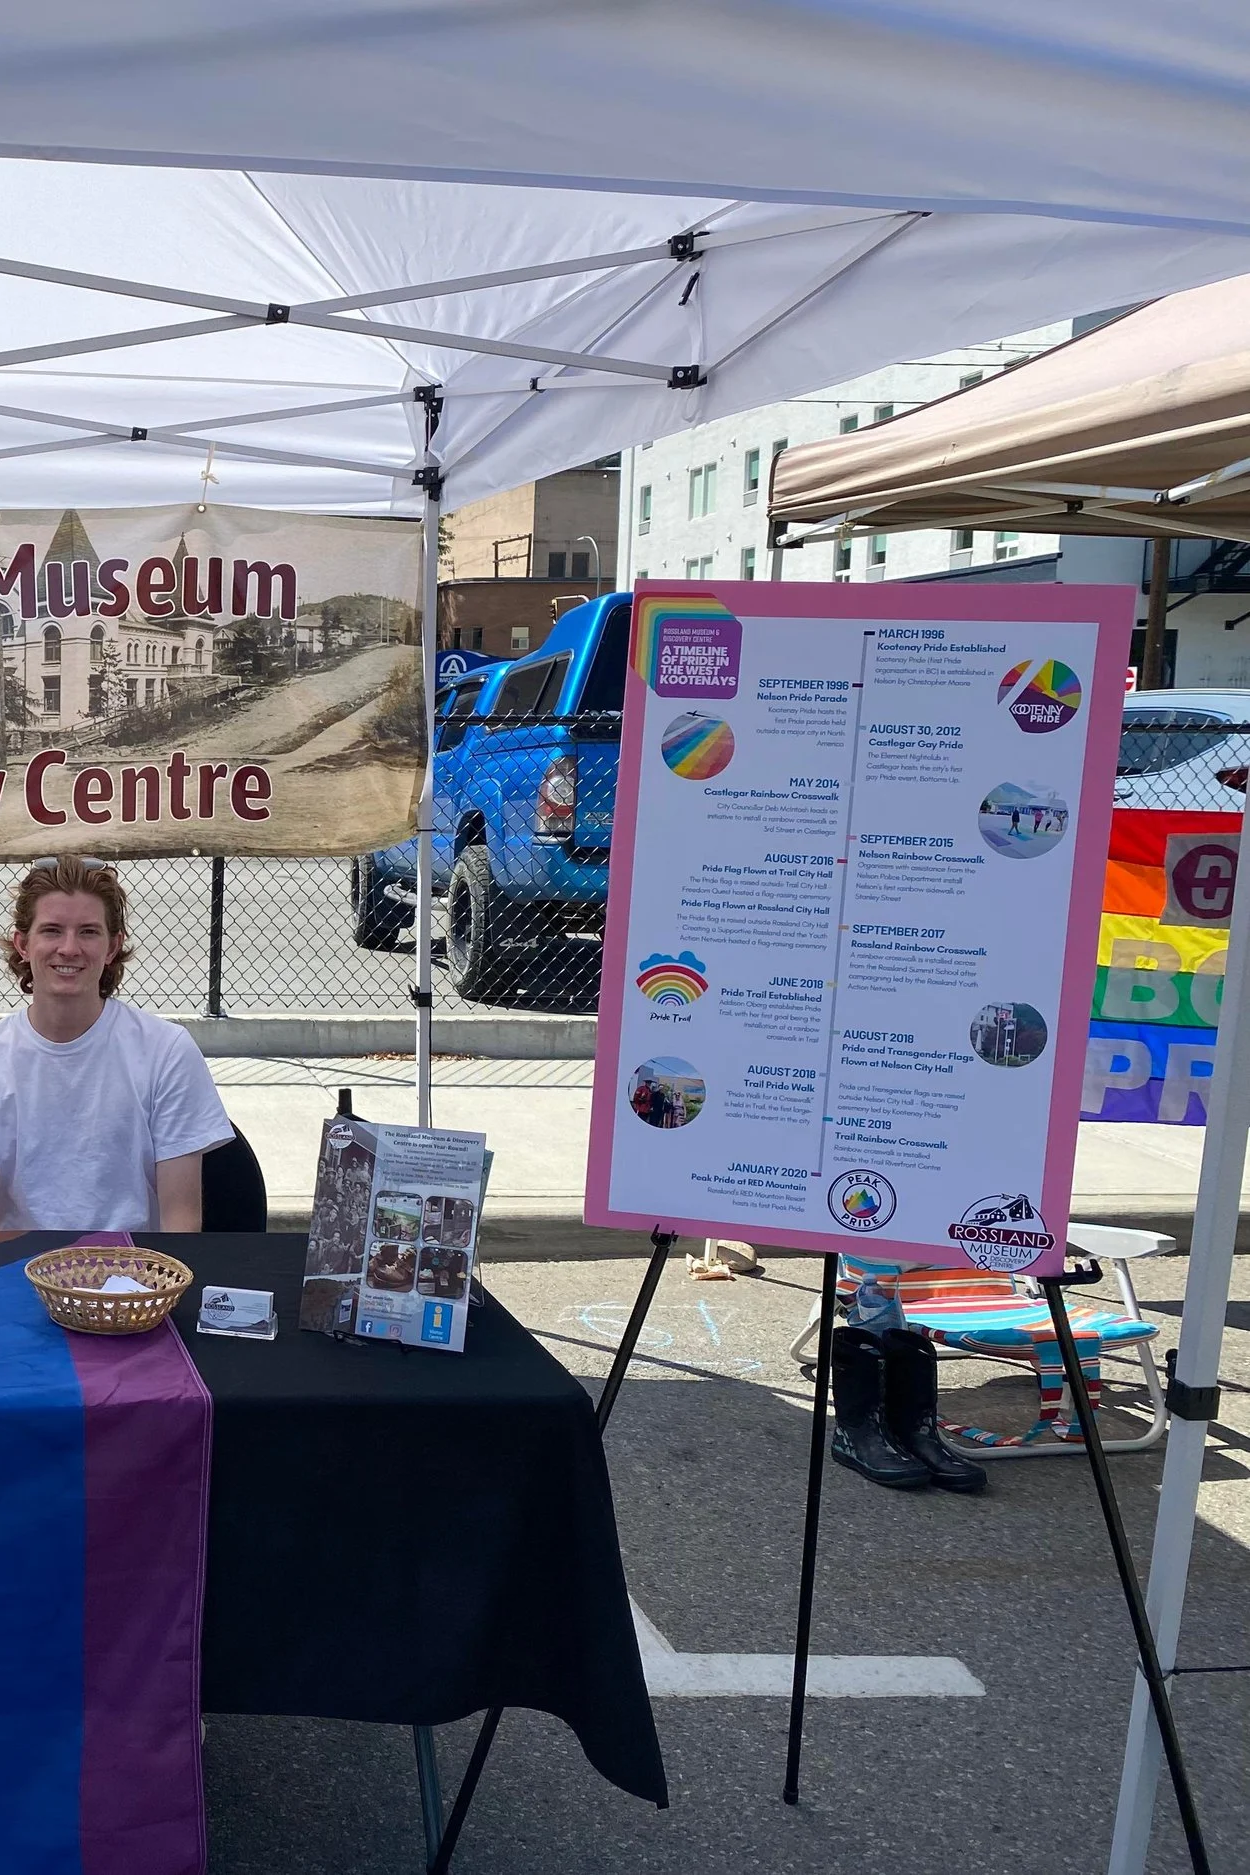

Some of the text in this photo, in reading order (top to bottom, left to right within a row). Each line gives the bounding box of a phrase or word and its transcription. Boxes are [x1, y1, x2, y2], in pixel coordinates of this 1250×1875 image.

[879, 629, 945, 639] MARCH 1996
[662, 645, 728, 656] A TIMELINE
[877, 642, 1006, 653] Kootenay Pride Established
[661, 655, 729, 667] OF PRIDE IN
[660, 665, 720, 676] THE WEST
[659, 674, 737, 686] KOOTENAYS
[759, 679, 849, 690] SEPTEMBER 1996
[757, 692, 848, 703] Nelson Pride Parade
[1010, 703, 1065, 715] KOOTENAY
[1030, 715, 1061, 724] PRIDE
[869, 724, 961, 736] AUGUST 30, 2012
[868, 738, 964, 751] Castlegar Gay Pride
[25, 749, 273, 826] Centre
[789, 778, 840, 789] MAY 2014
[704, 788, 839, 801] Castlegar Rainbow Crosswalk
[860, 834, 954, 848] SEPTEMBER 2015
[764, 854, 834, 866] AUGUST 2016
[859, 850, 985, 864] Nelson Rainbow Crosswalk
[724, 866, 742, 876] Flag
[743, 866, 767, 875] Flown
[798, 870, 816, 880] City
[855, 893, 902, 902] Stanley Street
[681, 899, 702, 907] Pride
[703, 900, 721, 910] Flag
[722, 901, 746, 910] Flown
[757, 904, 795, 913] Rossland
[795, 906, 813, 916] City
[813, 907, 830, 915] Hall
[852, 924, 945, 939] SEPTEMBER 2017
[851, 940, 987, 956] Rossland Rainbow Crosswalk
[769, 977, 824, 989] JUNE 2018
[847, 983, 897, 993] Action Network
[721, 988, 822, 1003] Pride Trail Established
[650, 1012, 692, 1023] Pride Trail
[843, 1030, 914, 1044] AUGUST 2018
[842, 1044, 974, 1063] Pride and Transgender Flags
[747, 1065, 816, 1079] AUGUST 2018
[841, 1057, 868, 1066] Flown
[881, 1060, 913, 1070] Nelson
[914, 1063, 934, 1074] City
[935, 1064, 953, 1073] Hall
[744, 1079, 815, 1092] Trail Pride Walk
[836, 1117, 892, 1130] JUNE 2019
[422, 1134, 445, 1142] Museum
[835, 1132, 948, 1149] Trail Rainbow Crosswalk
[728, 1163, 808, 1179] JANUARY 2020
[691, 1173, 712, 1182] Peak
[713, 1175, 736, 1184] Pride
[748, 1178, 764, 1187] RED
[765, 1180, 807, 1191] Mountain
[847, 1174, 881, 1188] PEAK
[841, 1212, 880, 1227] PRIDE
[953, 1225, 1050, 1248] ROSSLAND
[969, 1242, 1033, 1259] MUSEUM
[976, 1255, 992, 1272] &
[990, 1256, 1026, 1265] DISCOVERY
[990, 1261, 1014, 1270] CENTRE
